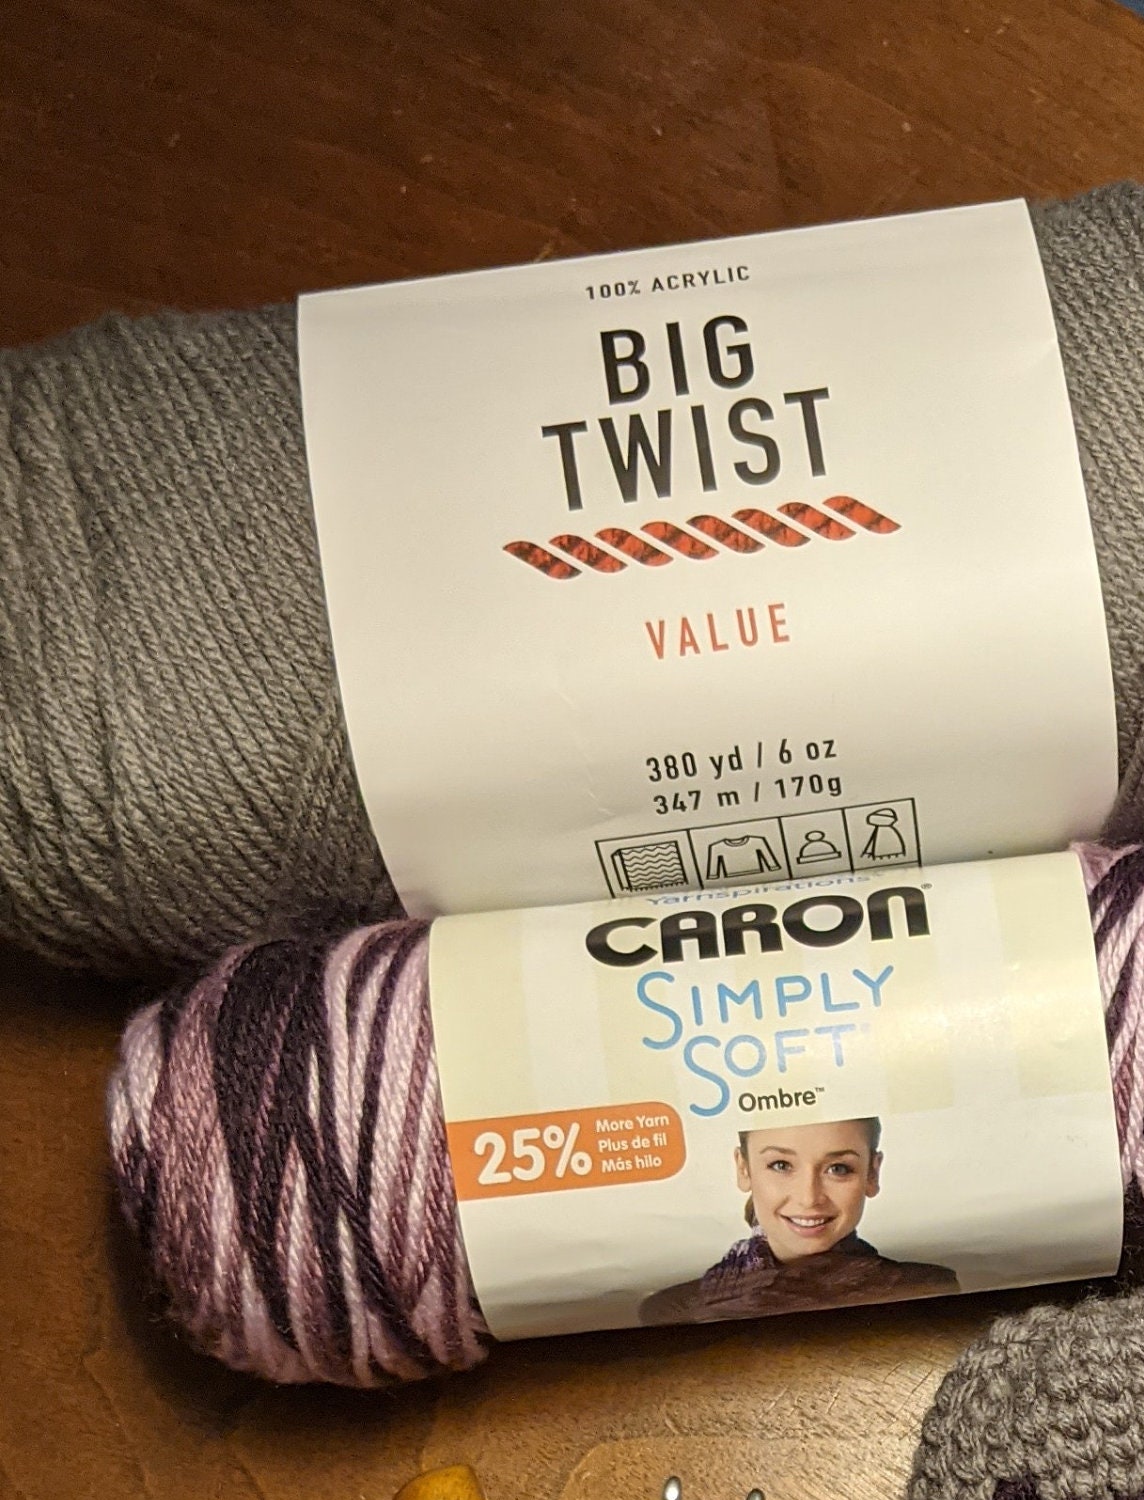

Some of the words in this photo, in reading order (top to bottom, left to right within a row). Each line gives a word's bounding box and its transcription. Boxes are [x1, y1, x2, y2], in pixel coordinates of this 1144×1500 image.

[585, 279, 642, 300] 100%
[651, 265, 751, 293] ACRYLIC
[600, 315, 755, 405] BIG
[541, 387, 830, 511] TWIST
[646, 602, 790, 659] VALUE
[646, 752, 697, 782] 380
[709, 745, 743, 780] yd
[779, 738, 792, 764] 6
[806, 739, 836, 760] oz
[653, 790, 701, 815] 347
[717, 790, 740, 807] m
[775, 774, 842, 797] 170g
[637, 965, 894, 1050] SIMPLY
[683, 1023, 856, 1117] SOFT
[596, 1118, 634, 1133] More
[635, 1114, 669, 1129] Yarn
[598, 1138, 628, 1153] Plus
[631, 1134, 650, 1149] de
[653, 1132, 668, 1147] fil
[474, 1122, 593, 1185] 25%
[601, 1157, 632, 1173] Más
[635, 1154, 662, 1169] hilo
